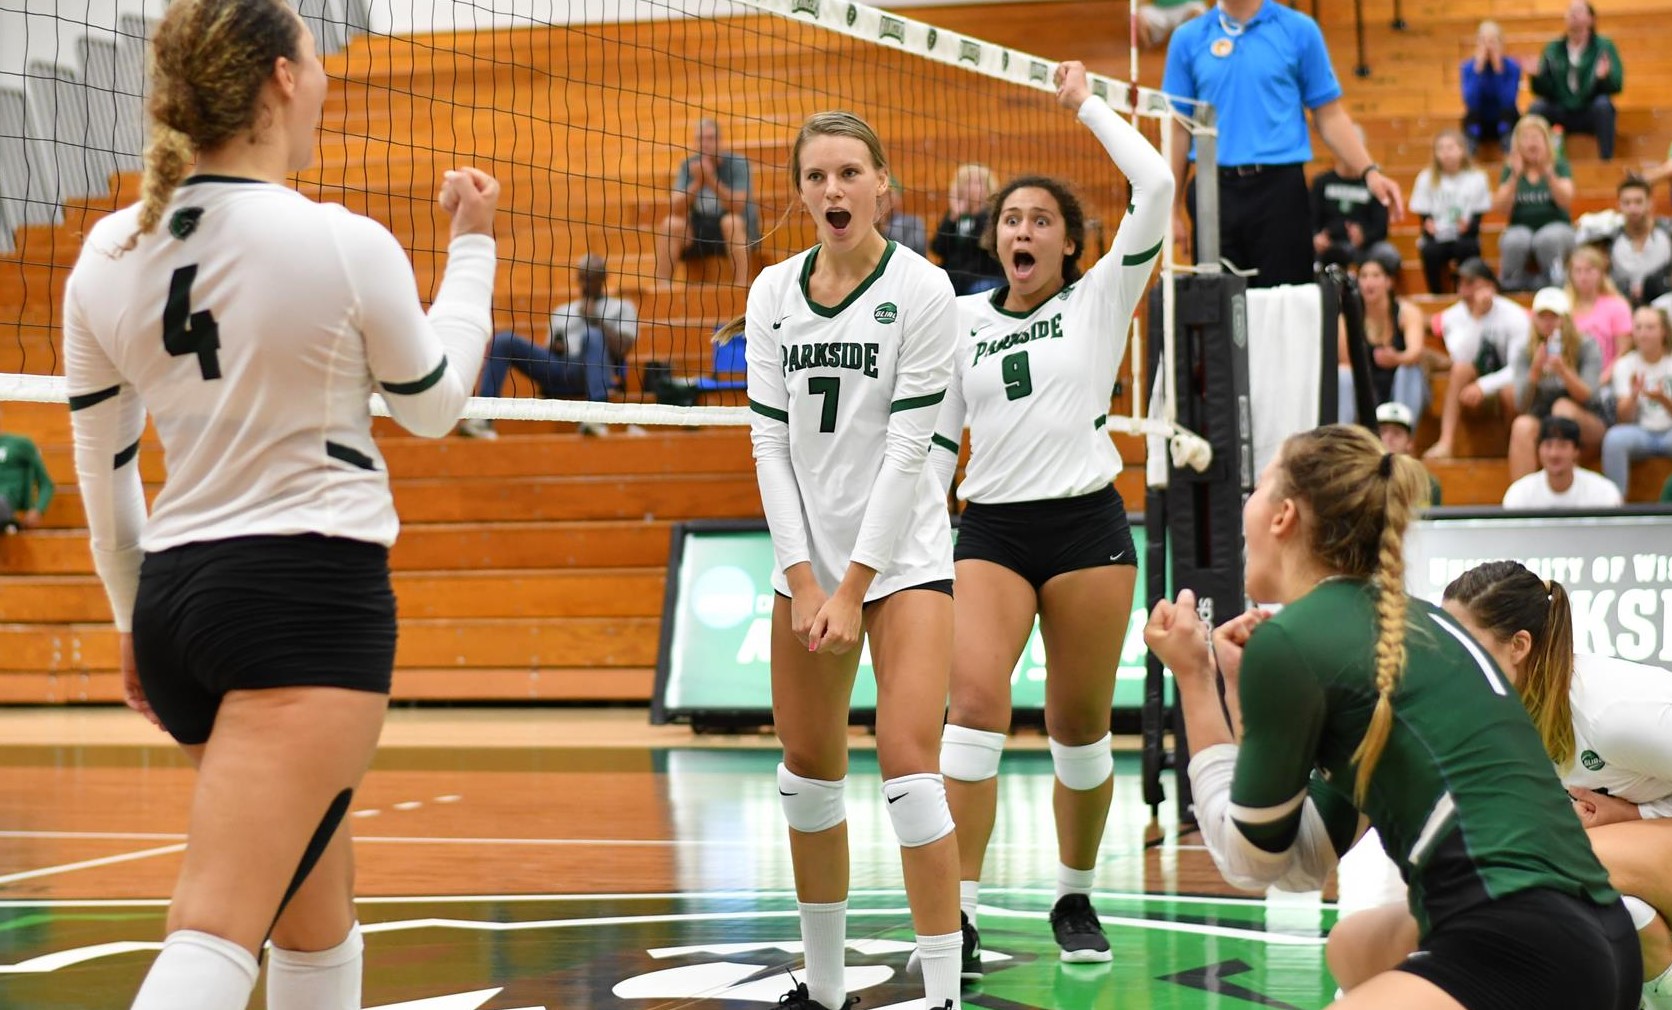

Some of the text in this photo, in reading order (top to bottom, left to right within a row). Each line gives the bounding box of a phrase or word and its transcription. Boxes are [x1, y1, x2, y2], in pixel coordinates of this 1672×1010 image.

[163, 263, 222, 380] 4
[781, 342, 879, 379] PARKSIDE
[1001, 350, 1033, 402] 9
[807, 376, 841, 433] 7
[1592, 556, 1625, 584] OF
